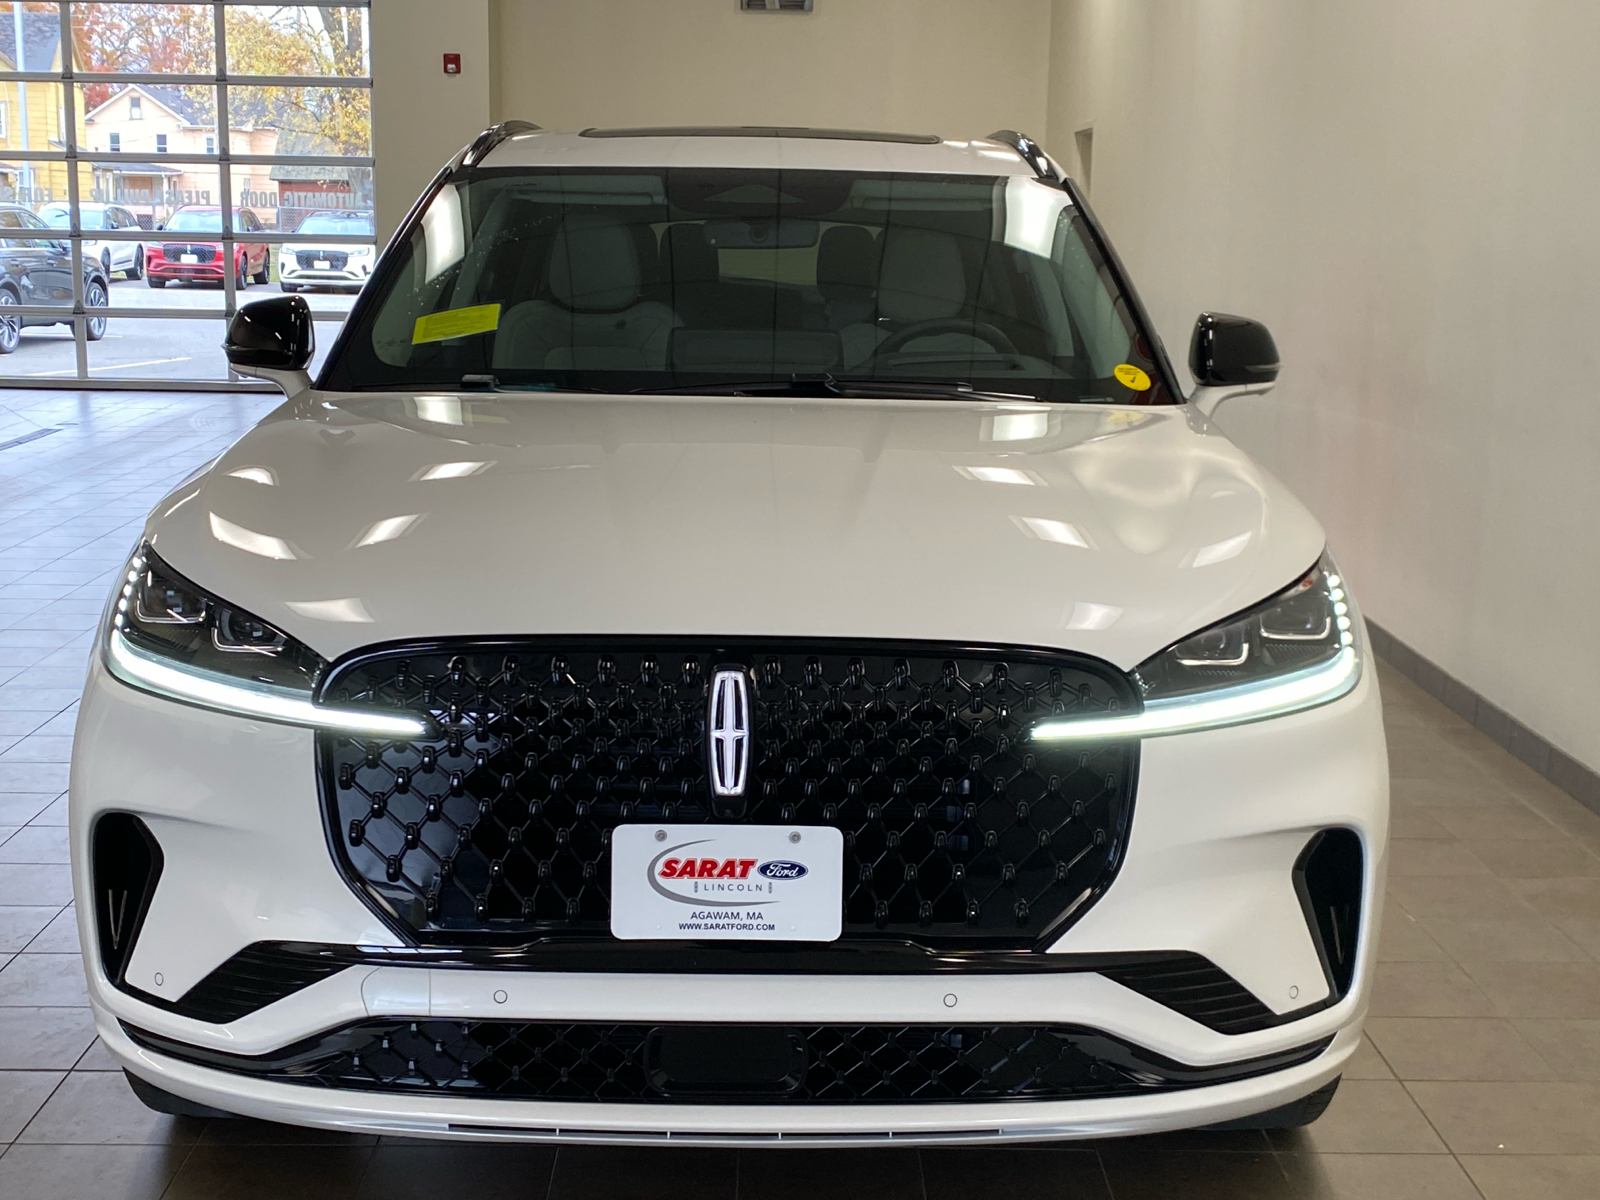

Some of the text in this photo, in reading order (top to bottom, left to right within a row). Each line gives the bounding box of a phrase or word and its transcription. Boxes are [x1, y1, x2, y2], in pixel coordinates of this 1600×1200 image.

[658, 858, 799, 879] SARAT Ford
[704, 883, 763, 892] LINCOLN
[690, 911, 764, 921] AGAWAM, MA
[678, 923, 775, 931] WWW.SARATFORD.COM
